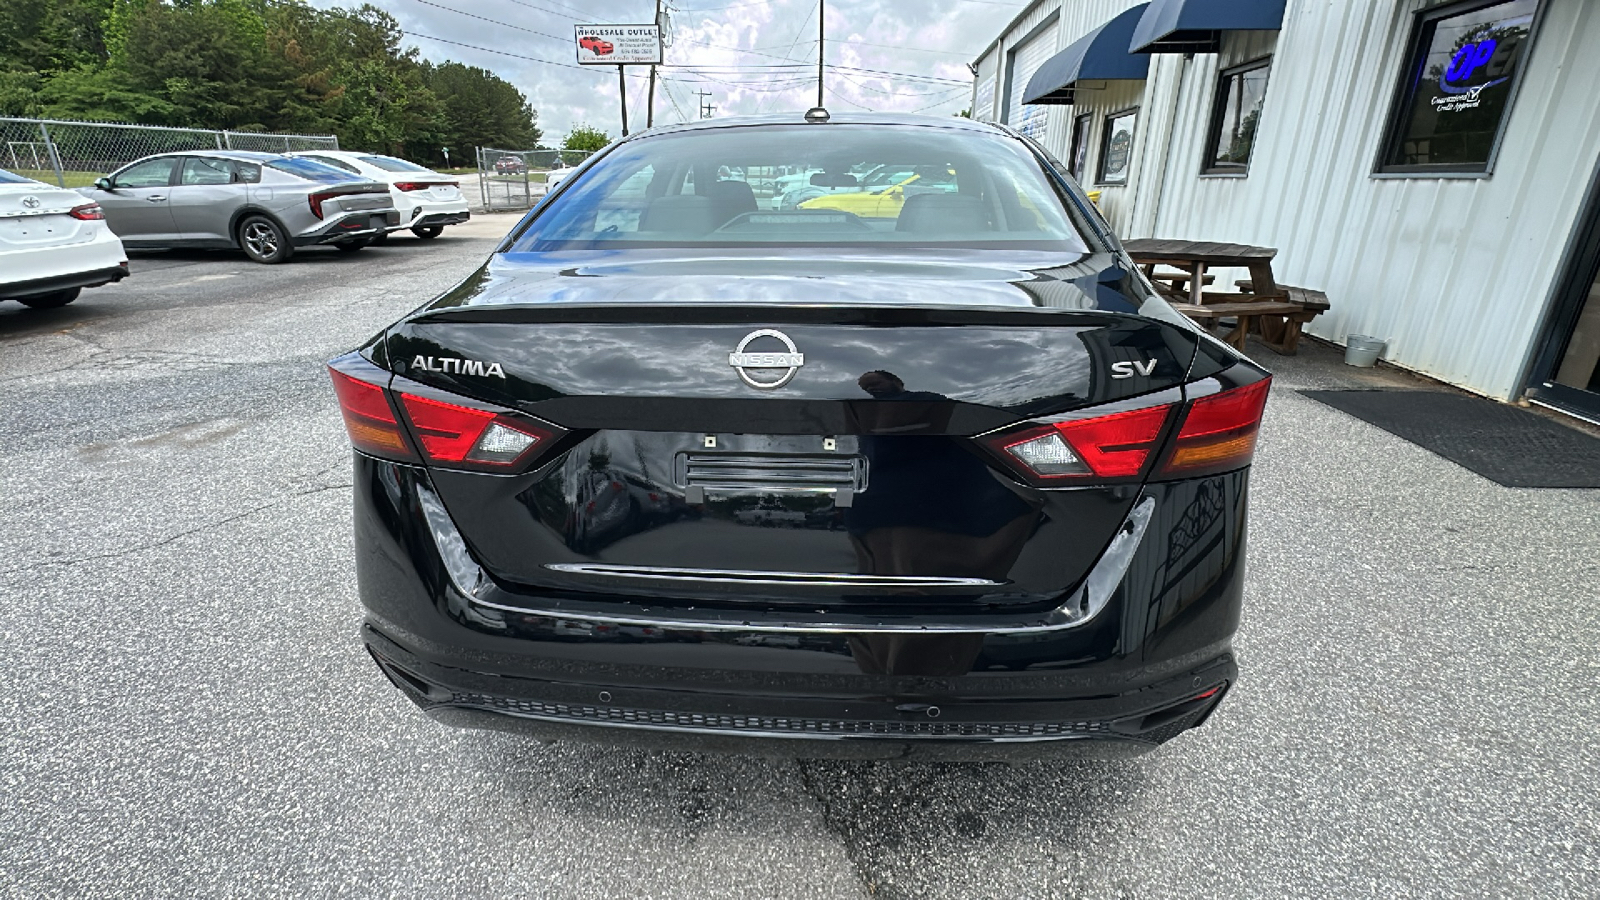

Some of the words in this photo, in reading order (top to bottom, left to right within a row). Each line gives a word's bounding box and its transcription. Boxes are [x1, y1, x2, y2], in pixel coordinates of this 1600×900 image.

[411, 354, 506, 379] ALTIMA
[730, 353, 803, 366] NISSAN
[1111, 358, 1158, 379] SV
